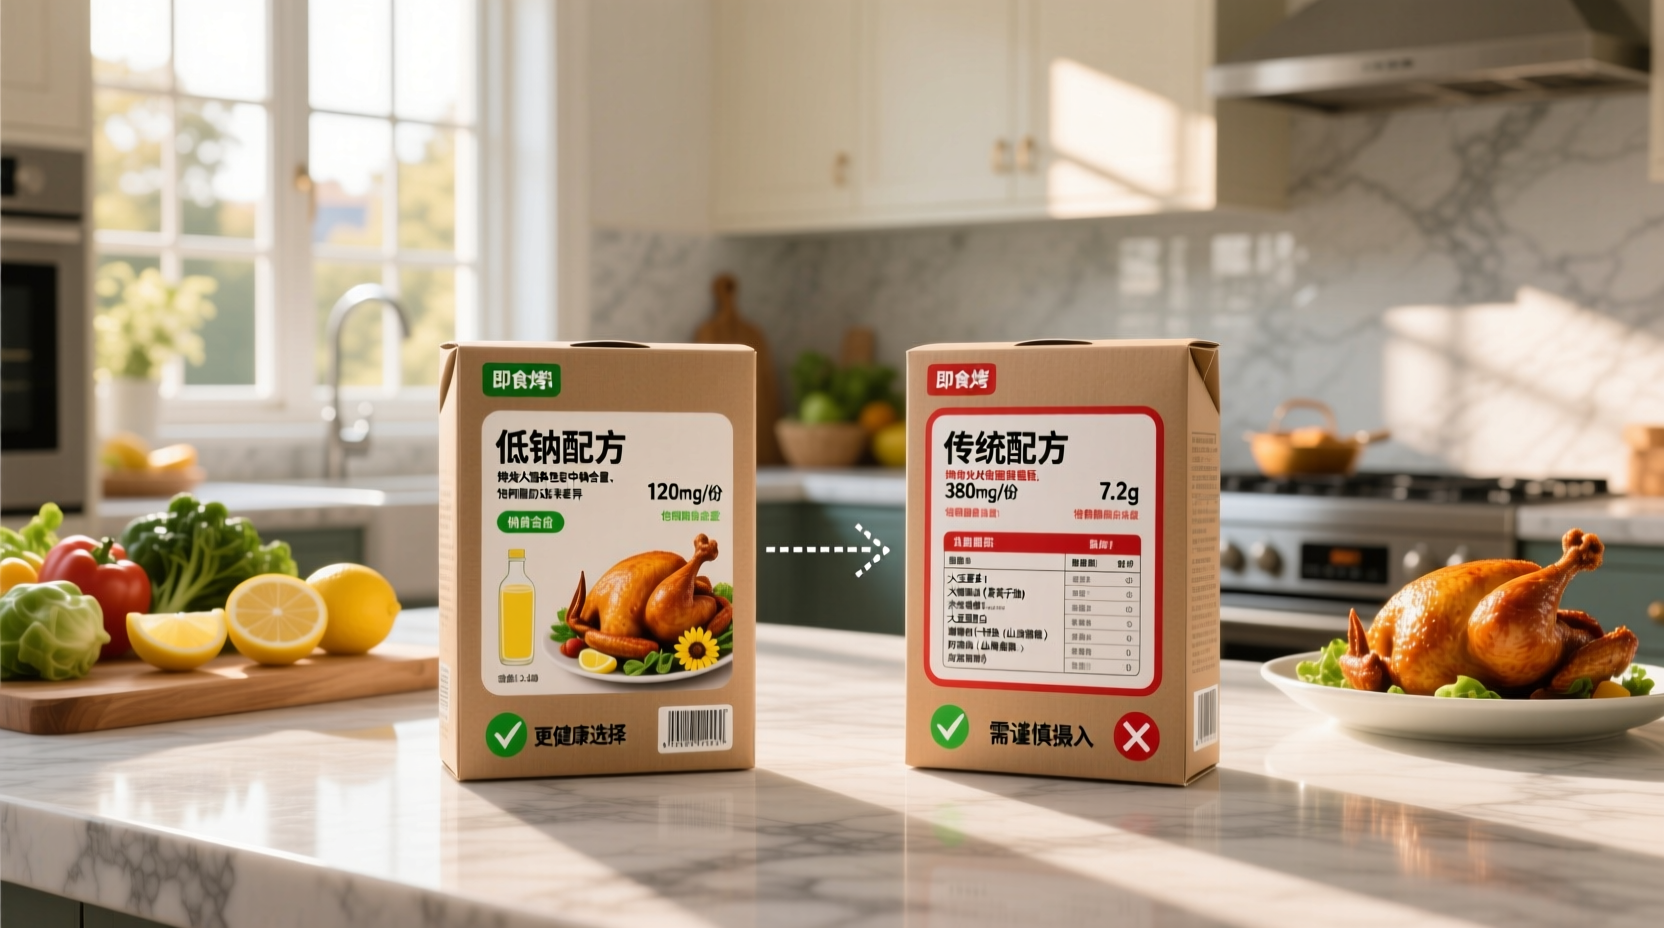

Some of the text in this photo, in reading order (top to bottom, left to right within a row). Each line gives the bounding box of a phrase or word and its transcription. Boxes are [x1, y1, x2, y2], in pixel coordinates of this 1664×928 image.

[495, 429, 626, 464] 低钠配方
[944, 430, 1069, 465] 传统配方
[648, 482, 723, 505] 120mg/份
[945, 482, 1018, 503] 380mg/份
[1099, 481, 1140, 505] 7.2g
[534, 723, 627, 747] 更健康选择
